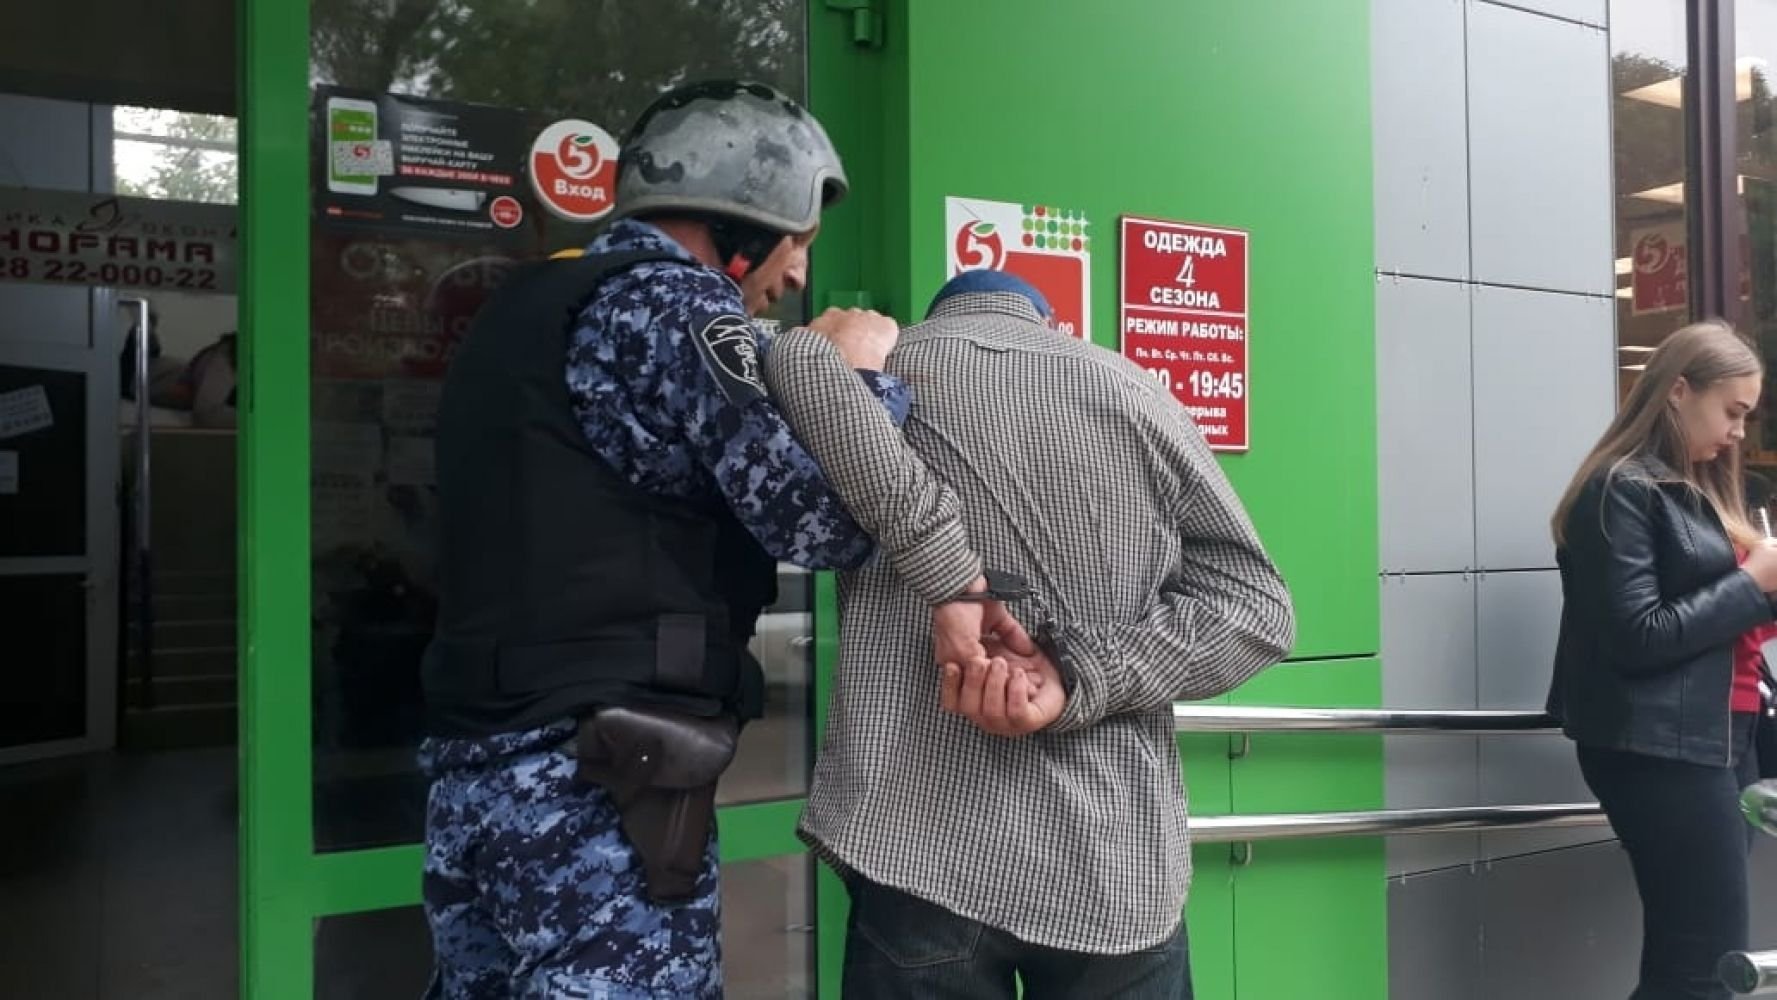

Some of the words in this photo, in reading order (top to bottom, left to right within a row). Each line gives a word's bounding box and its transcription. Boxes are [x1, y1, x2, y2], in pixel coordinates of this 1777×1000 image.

[554, 178, 607, 202] Вход
[1144, 230, 1227, 257] ОДЕЖДА
[44, 259, 217, 290] 22-000-22
[1175, 254, 1195, 288] 4
[1150, 286, 1220, 309] СЕЗОНА
[1126, 316, 1179, 337] РЕЖИМ
[1181, 319, 1244, 341] РАБОТЫ:
[1188, 369, 1244, 399] 19:45
